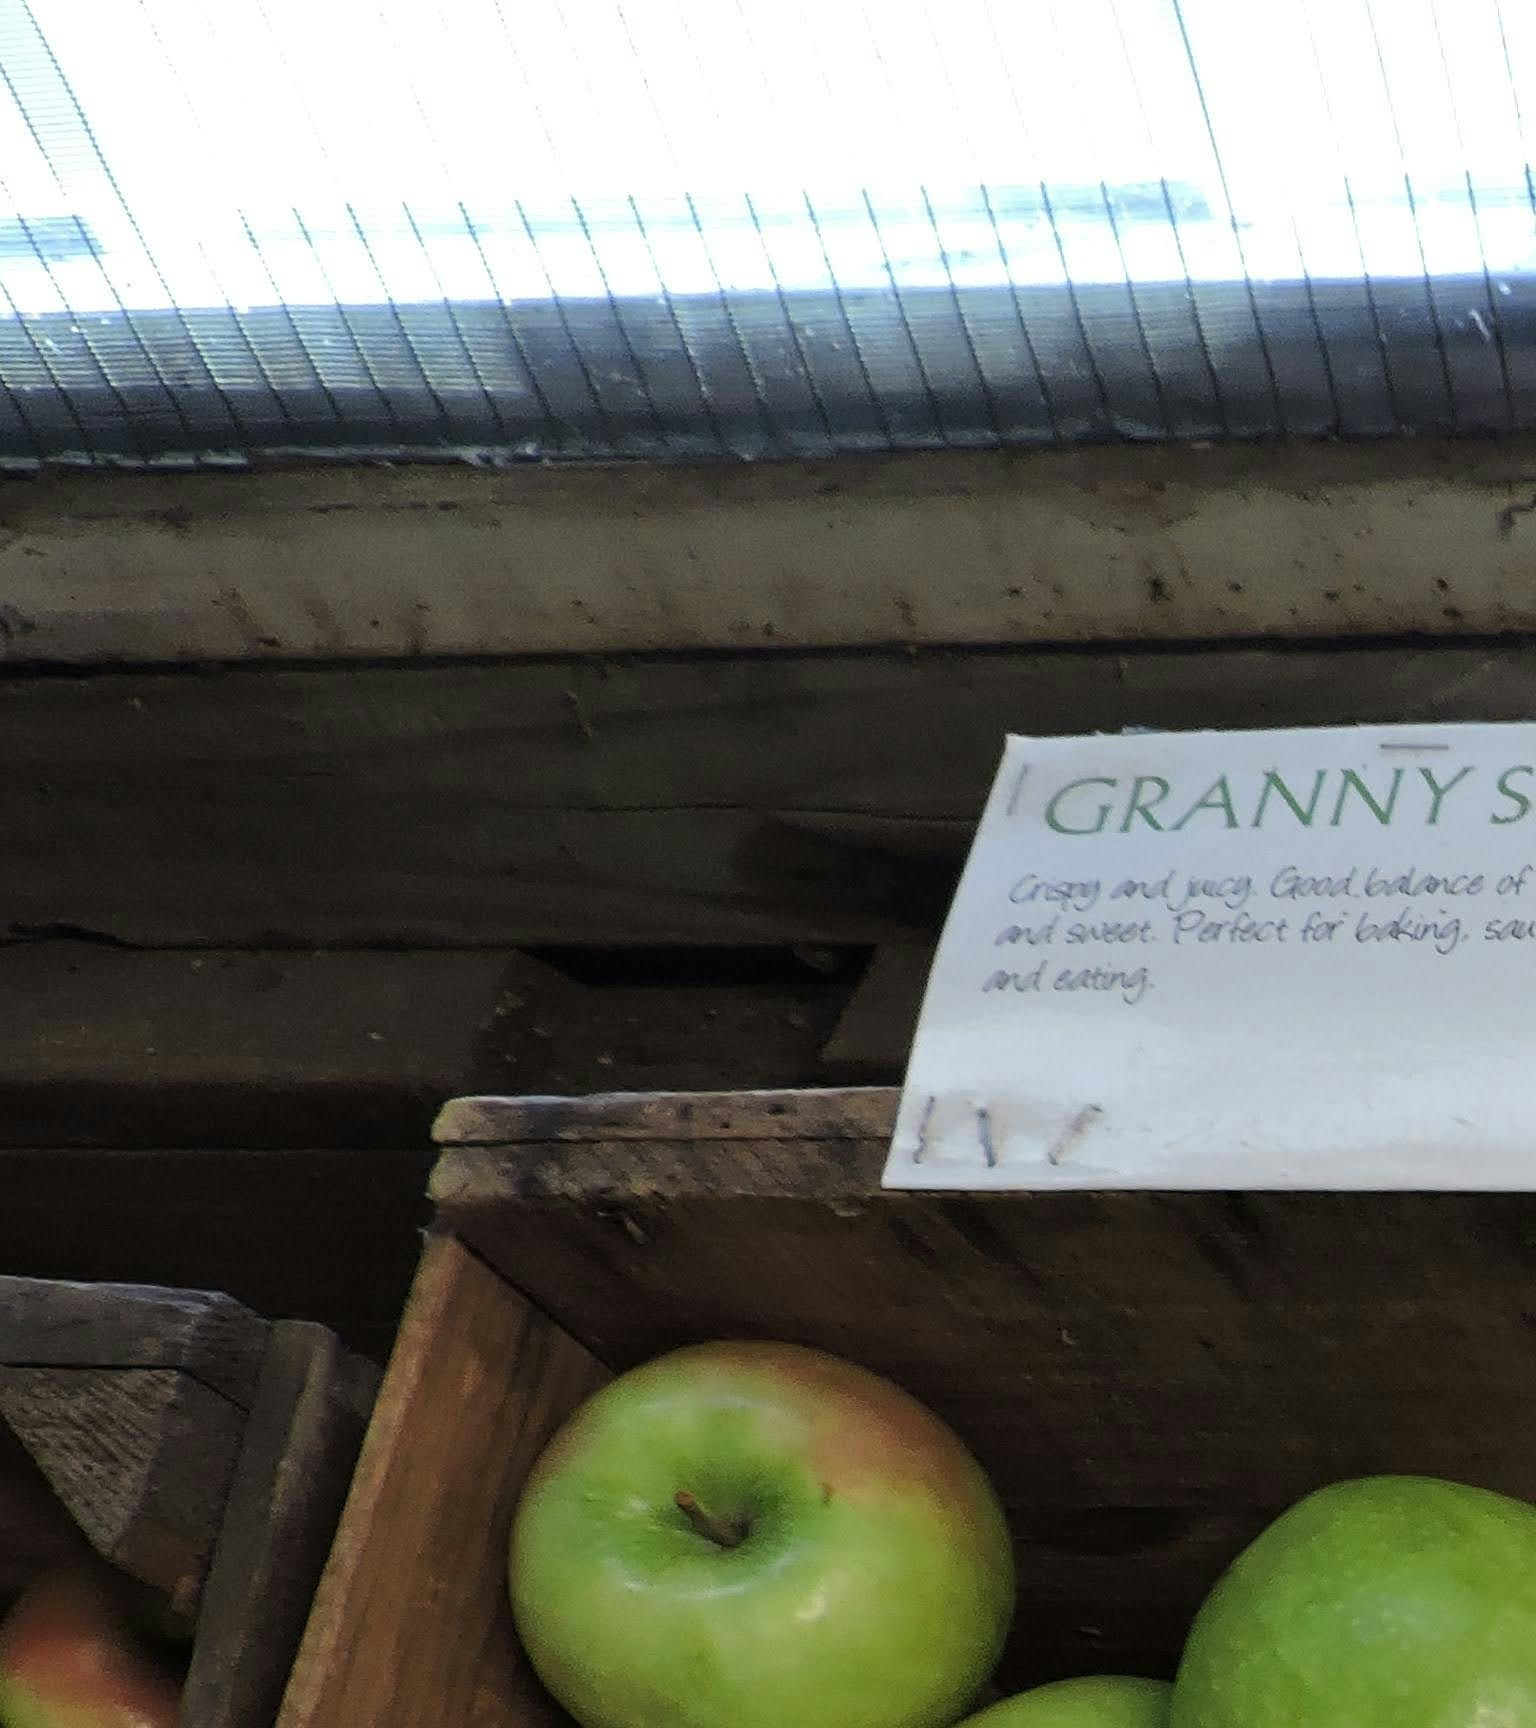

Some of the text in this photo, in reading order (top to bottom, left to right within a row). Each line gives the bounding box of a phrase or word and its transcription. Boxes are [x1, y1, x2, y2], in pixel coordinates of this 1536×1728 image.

[1043, 765, 1474, 836] GRANNY
[1008, 873, 1101, 912] Crispy
[1109, 869, 1177, 900] and
[1269, 865, 1359, 900] Good
[1364, 866, 1485, 897] balance
[1495, 864, 1534, 896] of
[994, 914, 1062, 946] and
[1172, 909, 1289, 945] Perfect
[1301, 911, 1344, 943] for
[981, 959, 1049, 993] and
